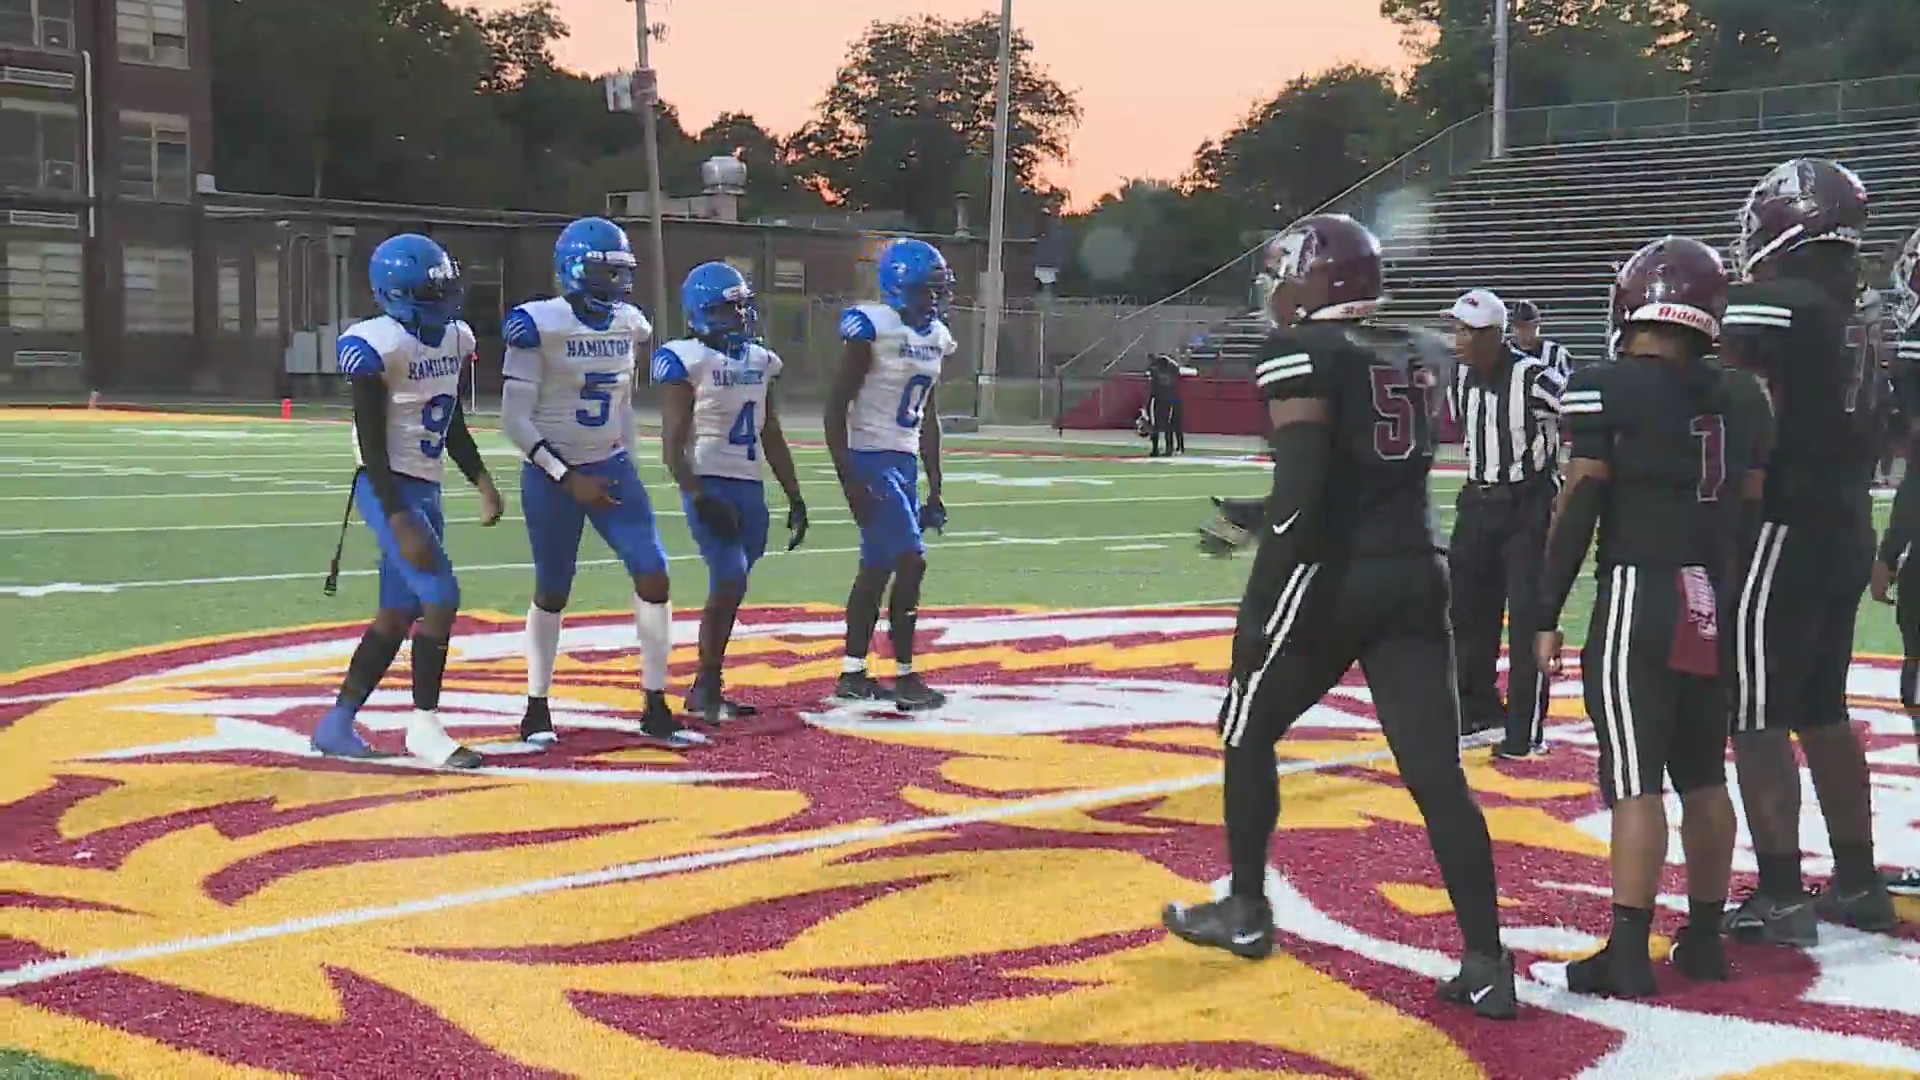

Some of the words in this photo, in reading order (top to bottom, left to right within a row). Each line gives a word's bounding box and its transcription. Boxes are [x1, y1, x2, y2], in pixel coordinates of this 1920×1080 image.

[420, 393, 456, 459] 9
[575, 371, 618, 427] 5
[896, 375, 932, 428] 0
[729, 400, 757, 461] 4
[1690, 414, 1726, 501] 1
